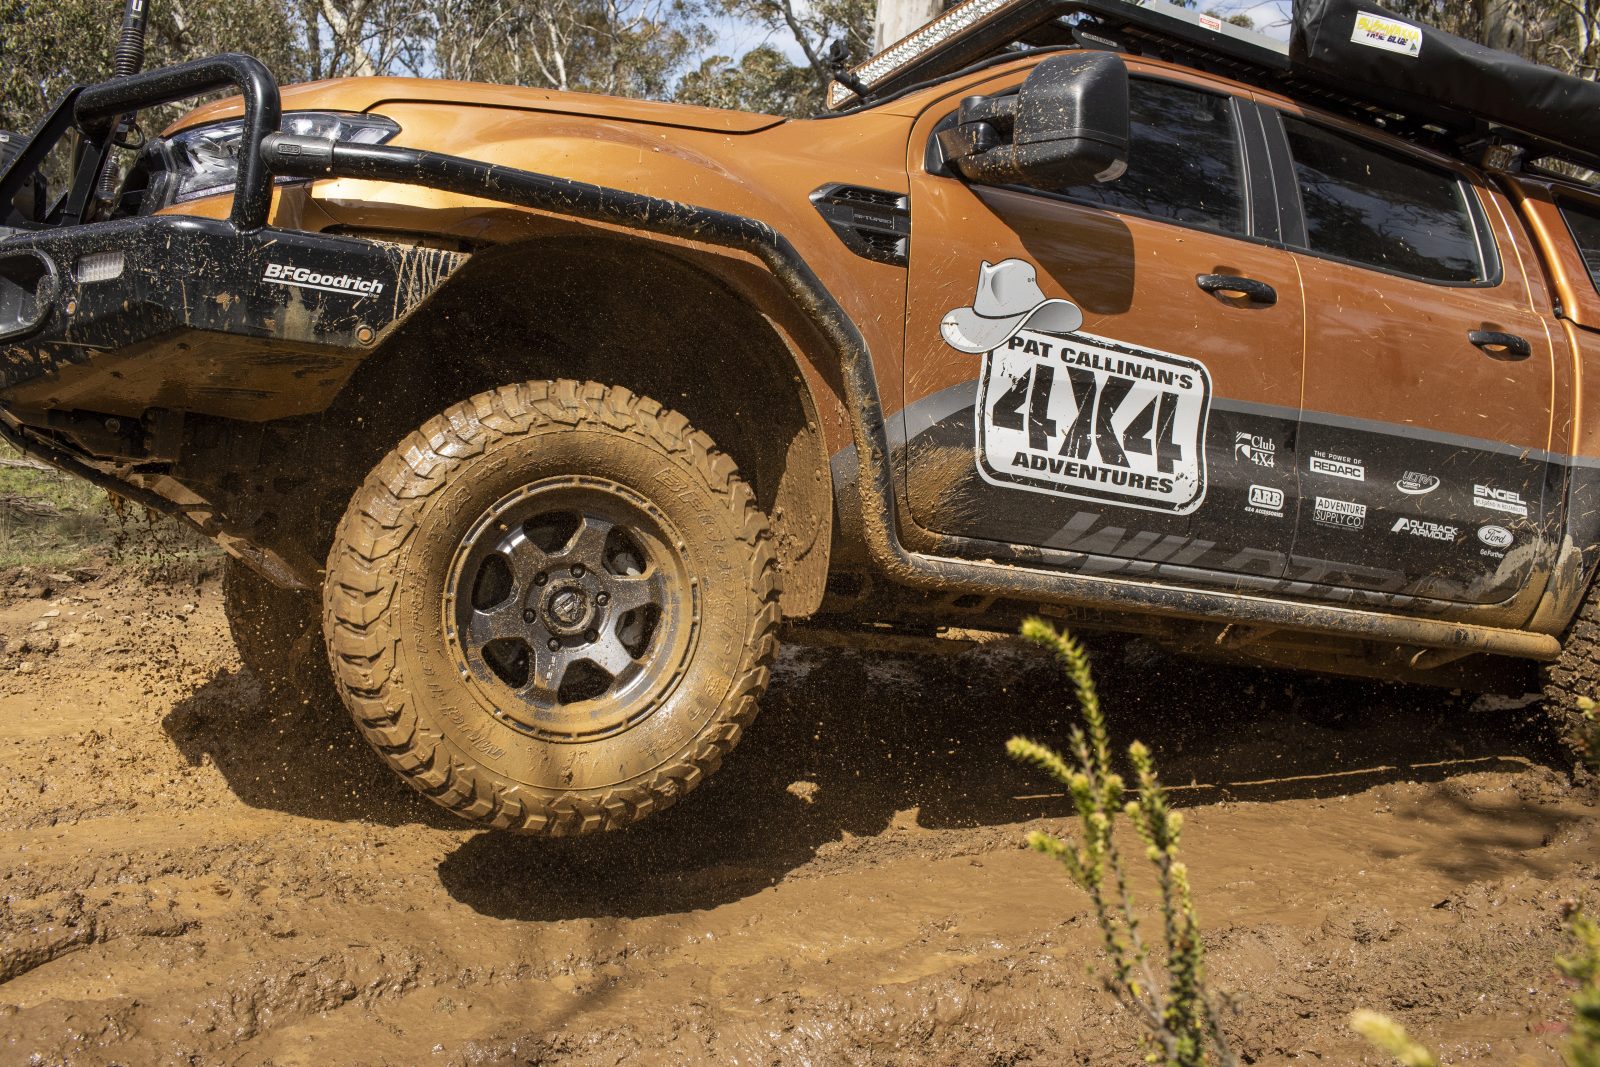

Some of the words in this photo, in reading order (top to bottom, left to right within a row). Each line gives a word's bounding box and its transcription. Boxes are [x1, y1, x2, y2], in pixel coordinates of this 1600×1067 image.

[1387, 35, 1409, 46] BLUE
[263, 263, 384, 294] BFGoodrich
[1007, 335, 1053, 358] PAT
[1060, 347, 1193, 389] CALLINAN'S
[992, 362, 1182, 475] 4X4
[1251, 435, 1276, 452] Club
[1250, 452, 1275, 468] 4X4
[1313, 450, 1326, 458] THE
[1328, 453, 1352, 464] POWER
[1011, 452, 1174, 494] ADVENTURES
[1313, 460, 1361, 478] REDARC
[1252, 488, 1281, 506] ARB
[1473, 484, 1527, 505] ENGEL
[1317, 498, 1365, 517] ADVENTURE
[1315, 509, 1346, 525] SUPPLY
[1409, 528, 1456, 542] ARMOUR
[1410, 519, 1459, 536] OUTBACK
[1484, 528, 1507, 544] Ford
[1487, 550, 1504, 559] Further
